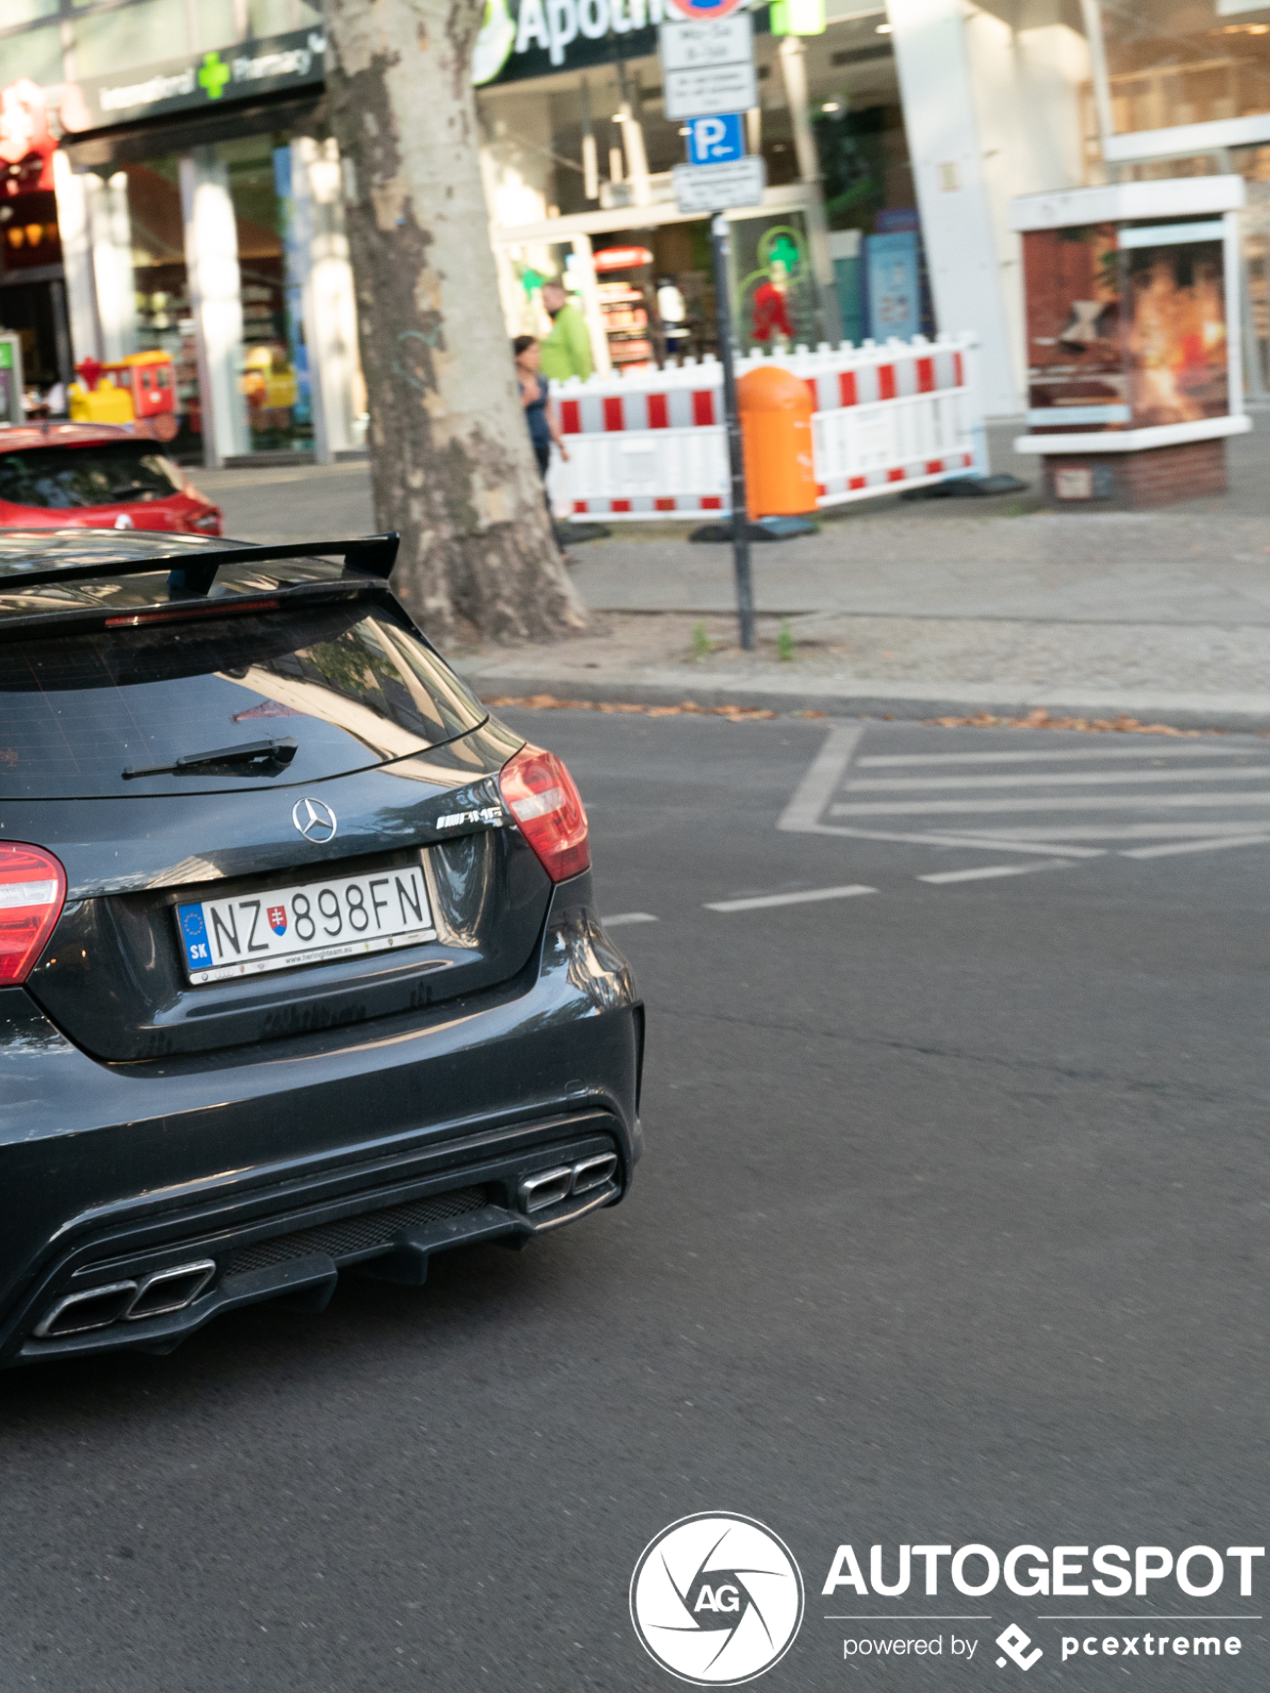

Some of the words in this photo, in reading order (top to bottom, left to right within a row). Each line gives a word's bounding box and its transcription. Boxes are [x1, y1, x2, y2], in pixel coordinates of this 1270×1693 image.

[693, 117, 727, 160] P
[210, 899, 270, 959] NZ
[290, 873, 424, 943] 898FN
[190, 943, 208, 959] SK
